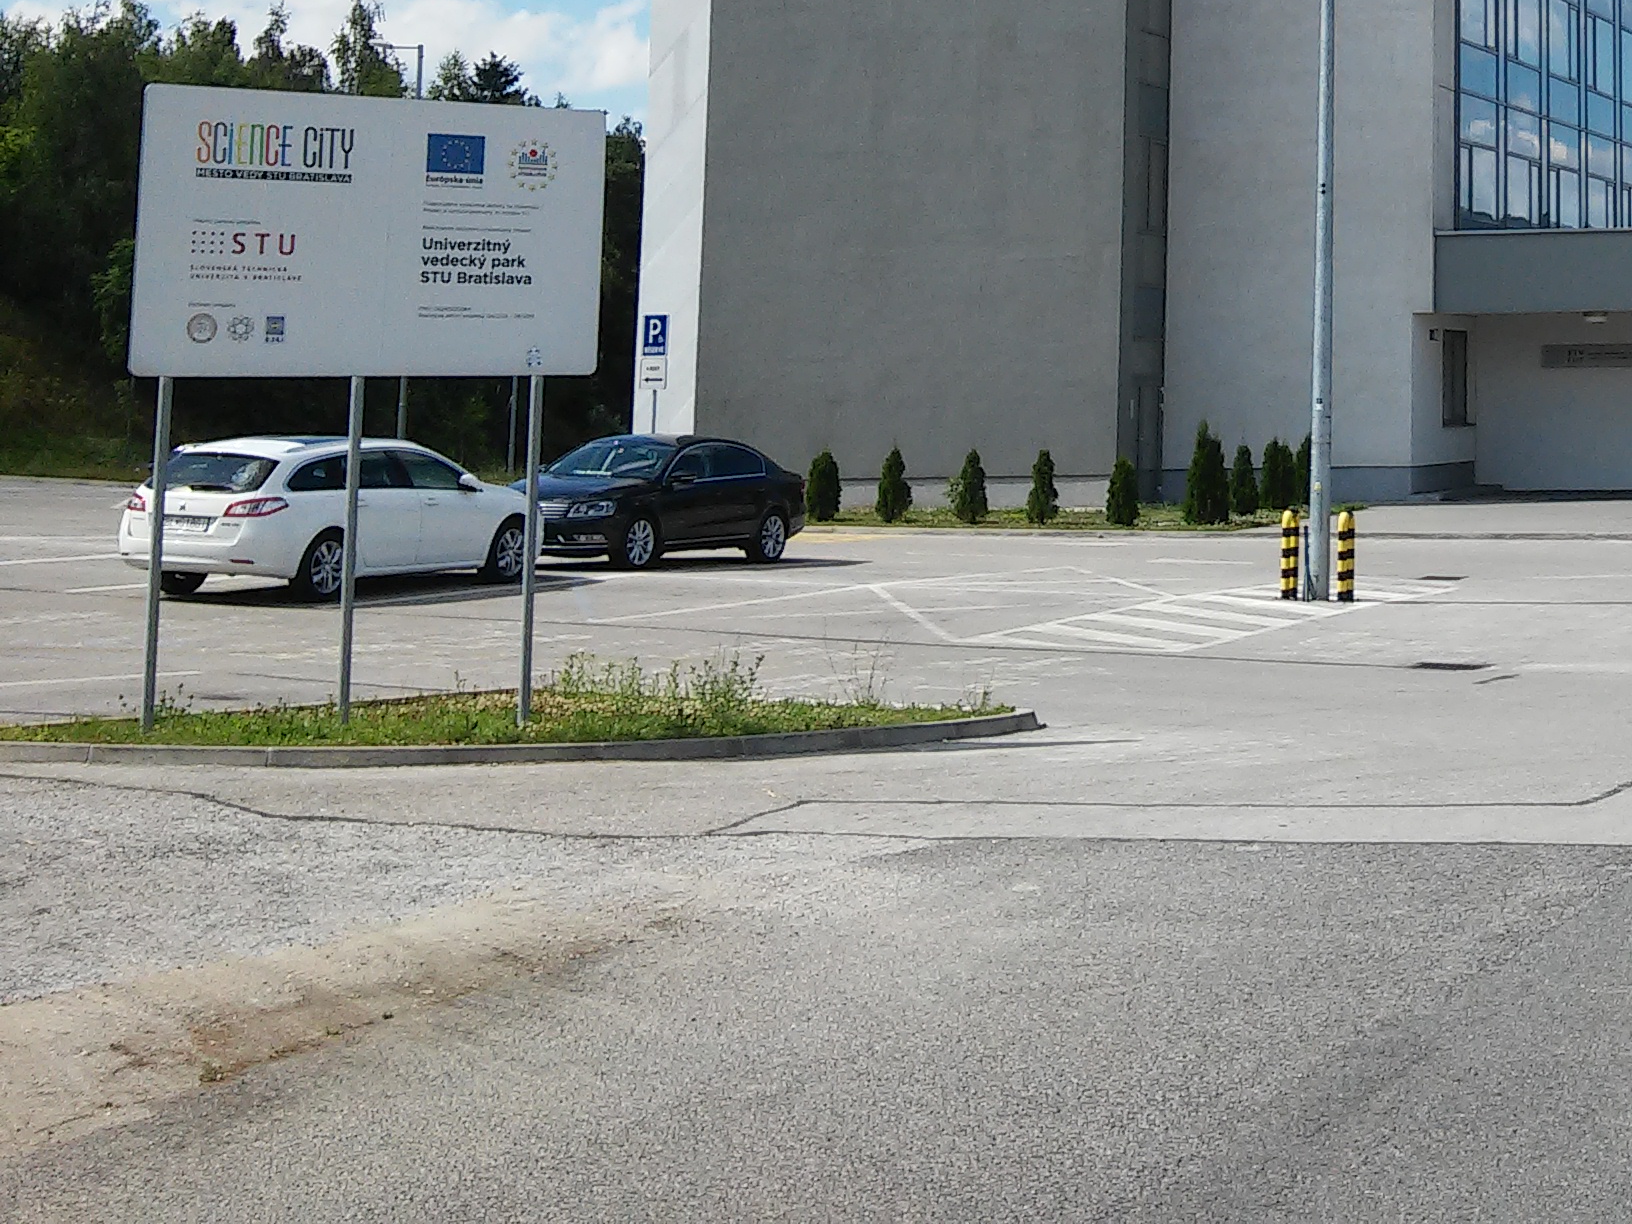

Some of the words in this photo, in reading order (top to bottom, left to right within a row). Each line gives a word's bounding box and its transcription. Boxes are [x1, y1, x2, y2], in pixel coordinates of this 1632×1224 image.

[196, 168, 232, 178] MESTO
[237, 169, 264, 179] VEDY
[267, 171, 287, 181] STU
[290, 171, 352, 183] BRATISLAVA
[231, 232, 297, 256] STU
[422, 237, 511, 254] Univerzitný
[420, 254, 487, 270] vedecký
[491, 255, 526, 269] park
[420, 271, 452, 284] STU
[456, 271, 533, 285] Bratislava
[648, 318, 662, 344] P
